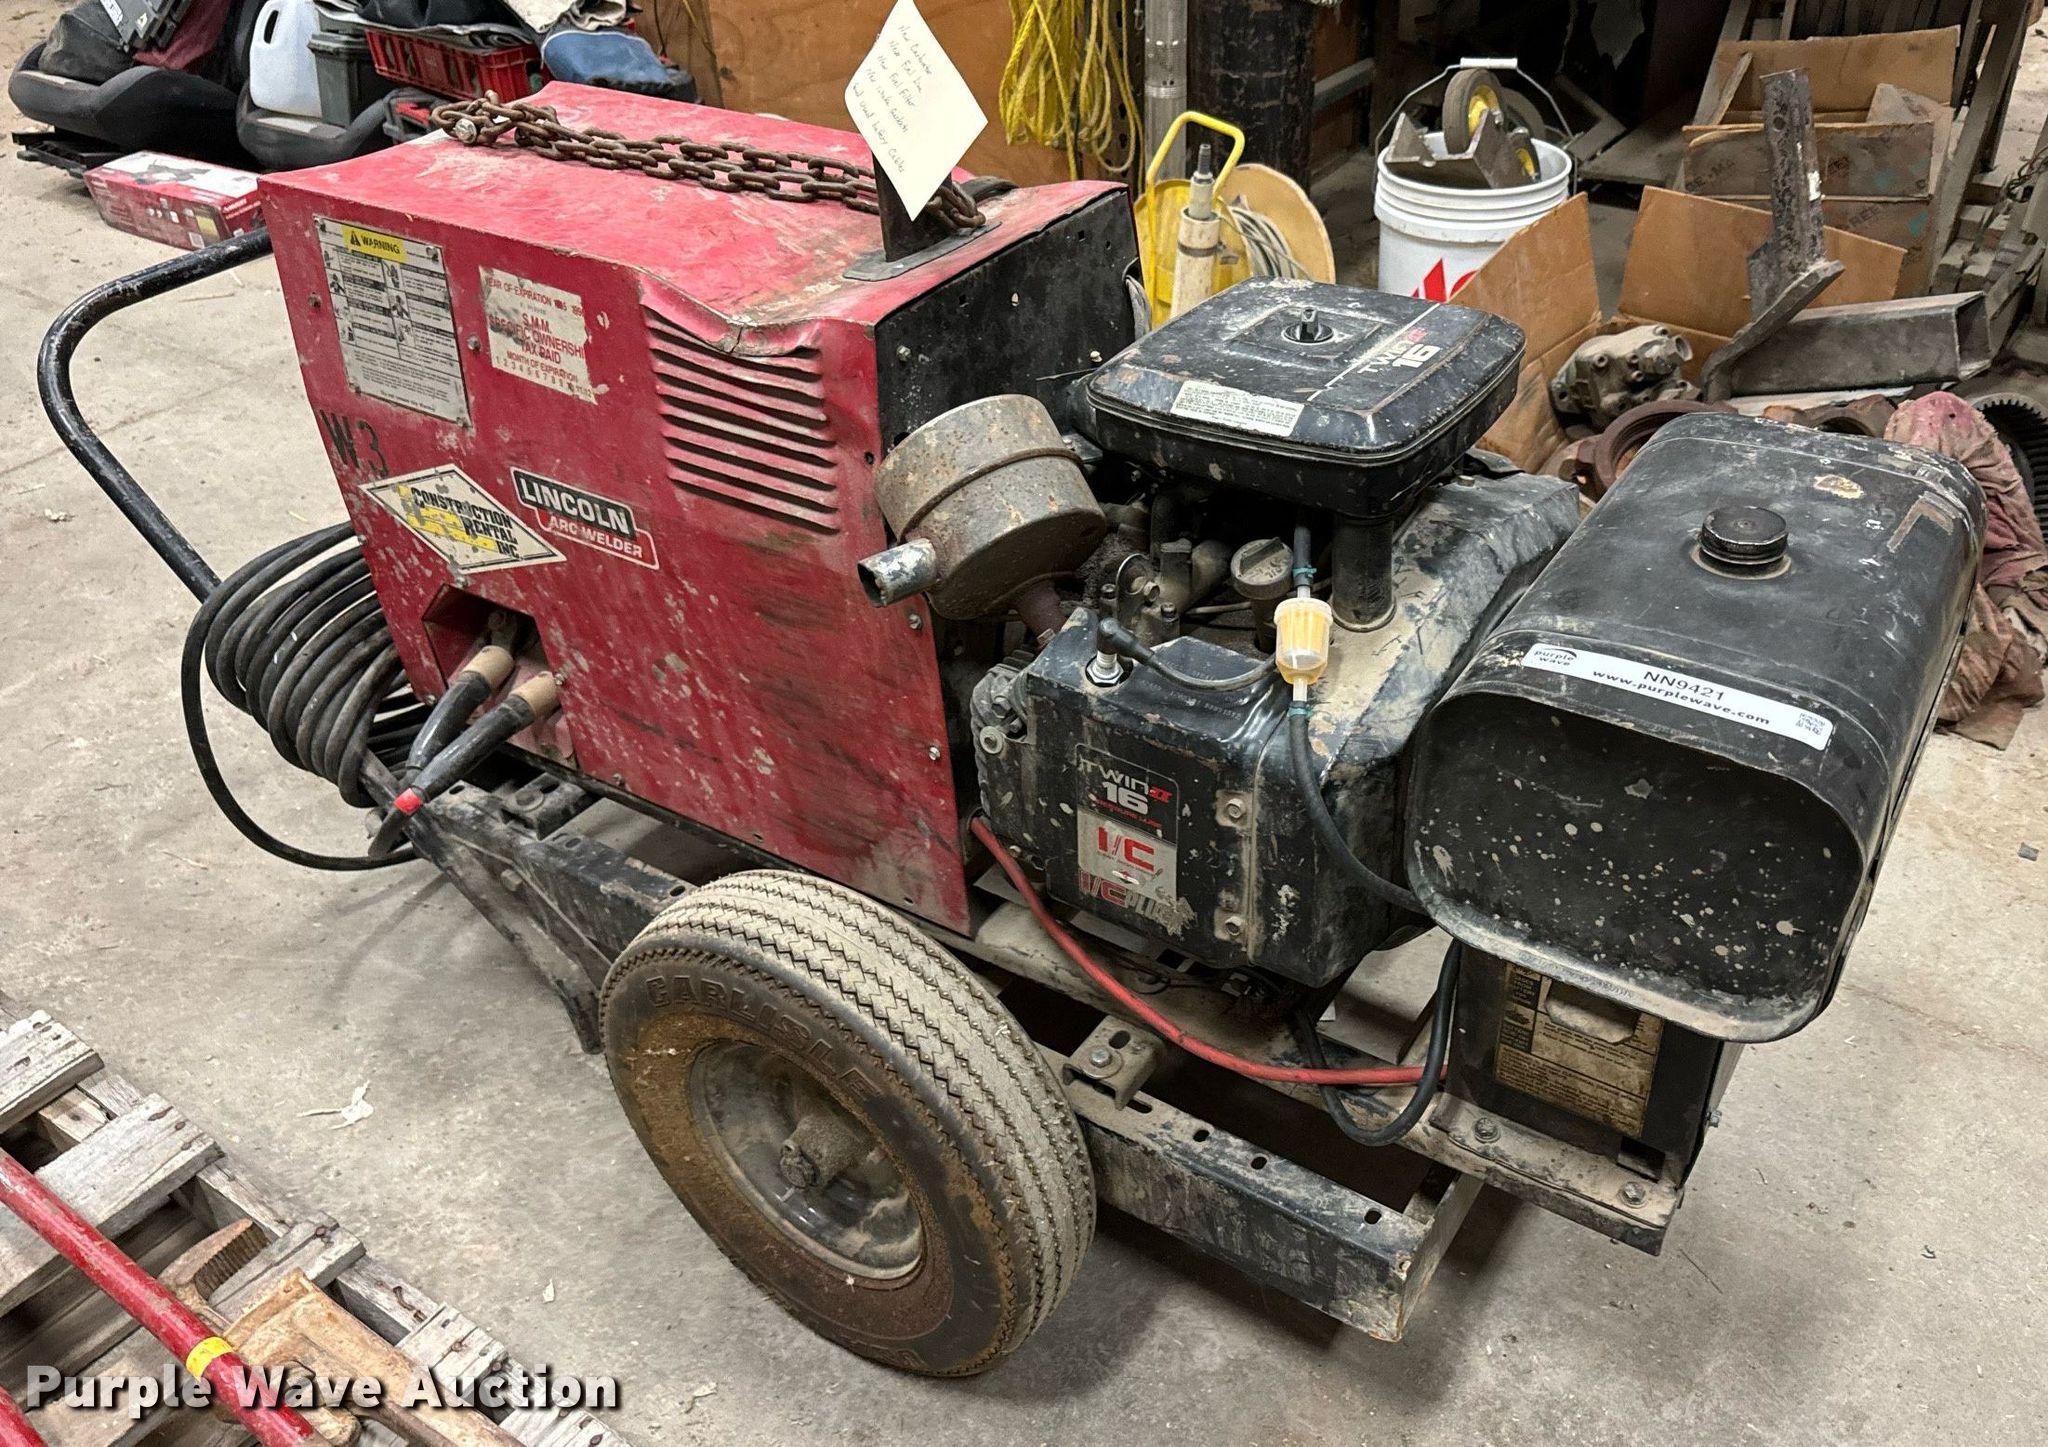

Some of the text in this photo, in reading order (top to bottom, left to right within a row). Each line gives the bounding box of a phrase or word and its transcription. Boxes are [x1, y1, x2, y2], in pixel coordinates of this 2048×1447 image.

[361, 235, 401, 254] WARNING
[503, 282, 514, 293] OF
[515, 285, 552, 306] EXPIRATION
[521, 341, 562, 364] TAX PAID
[532, 329, 585, 359] OWNERSHI
[1392, 343, 1440, 368] 16
[506, 351, 578, 383] MONTH OF EXPIRATION
[519, 477, 630, 535] LINCOLN
[460, 516, 518, 545] RENTAL
[549, 515, 643, 559] ARC WELDER
[1534, 650, 1574, 661] purple
[1540, 657, 1570, 666] wave
[1593, 670, 1769, 725] www.purplewave.com
[1643, 671, 1724, 701] NN9421
[1102, 781, 1149, 815] 16
[646, 976, 883, 1101] CARLISLE
